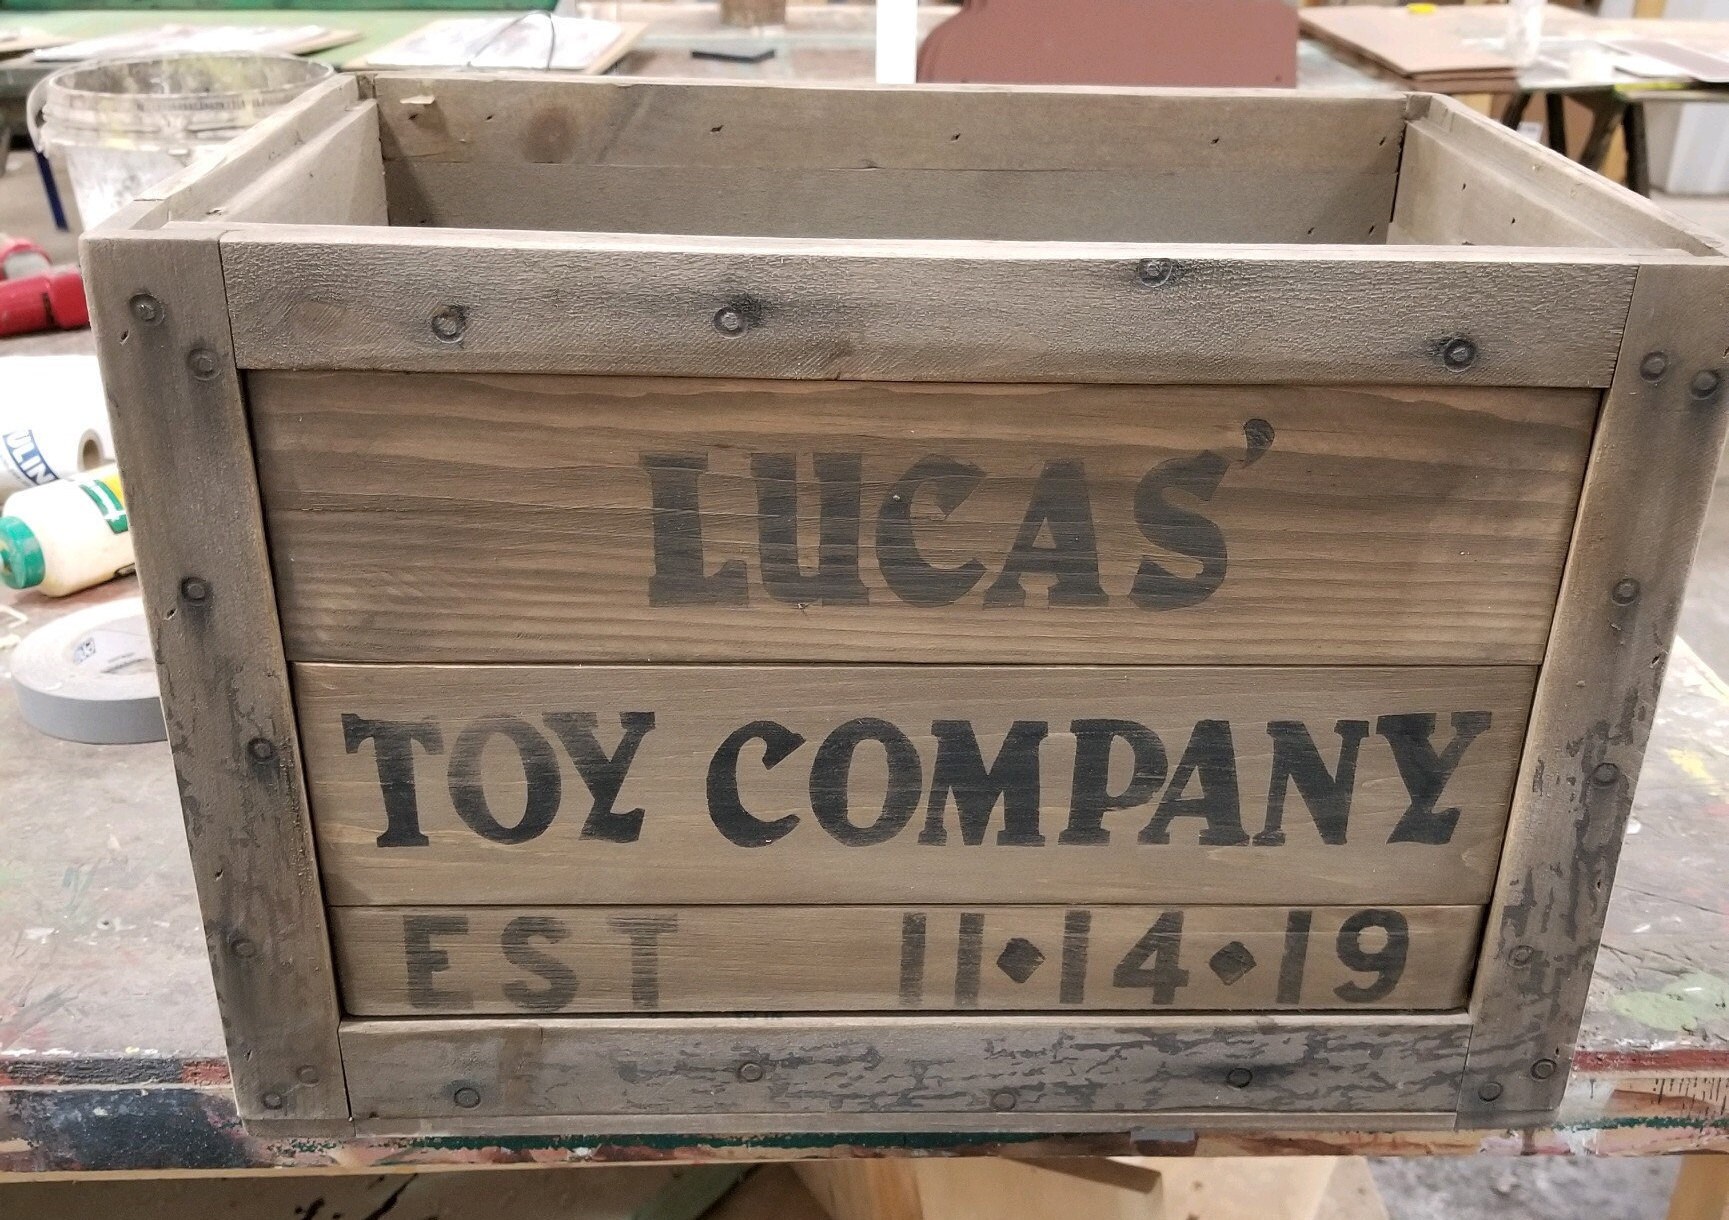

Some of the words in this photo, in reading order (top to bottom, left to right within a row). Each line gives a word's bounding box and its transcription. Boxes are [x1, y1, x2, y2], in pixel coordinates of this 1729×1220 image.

[638, 418, 1275, 612] LUCAS'
[341, 711, 656, 847] TOY
[705, 711, 1492, 848] COMPANY
[402, 913, 679, 1012] EST
